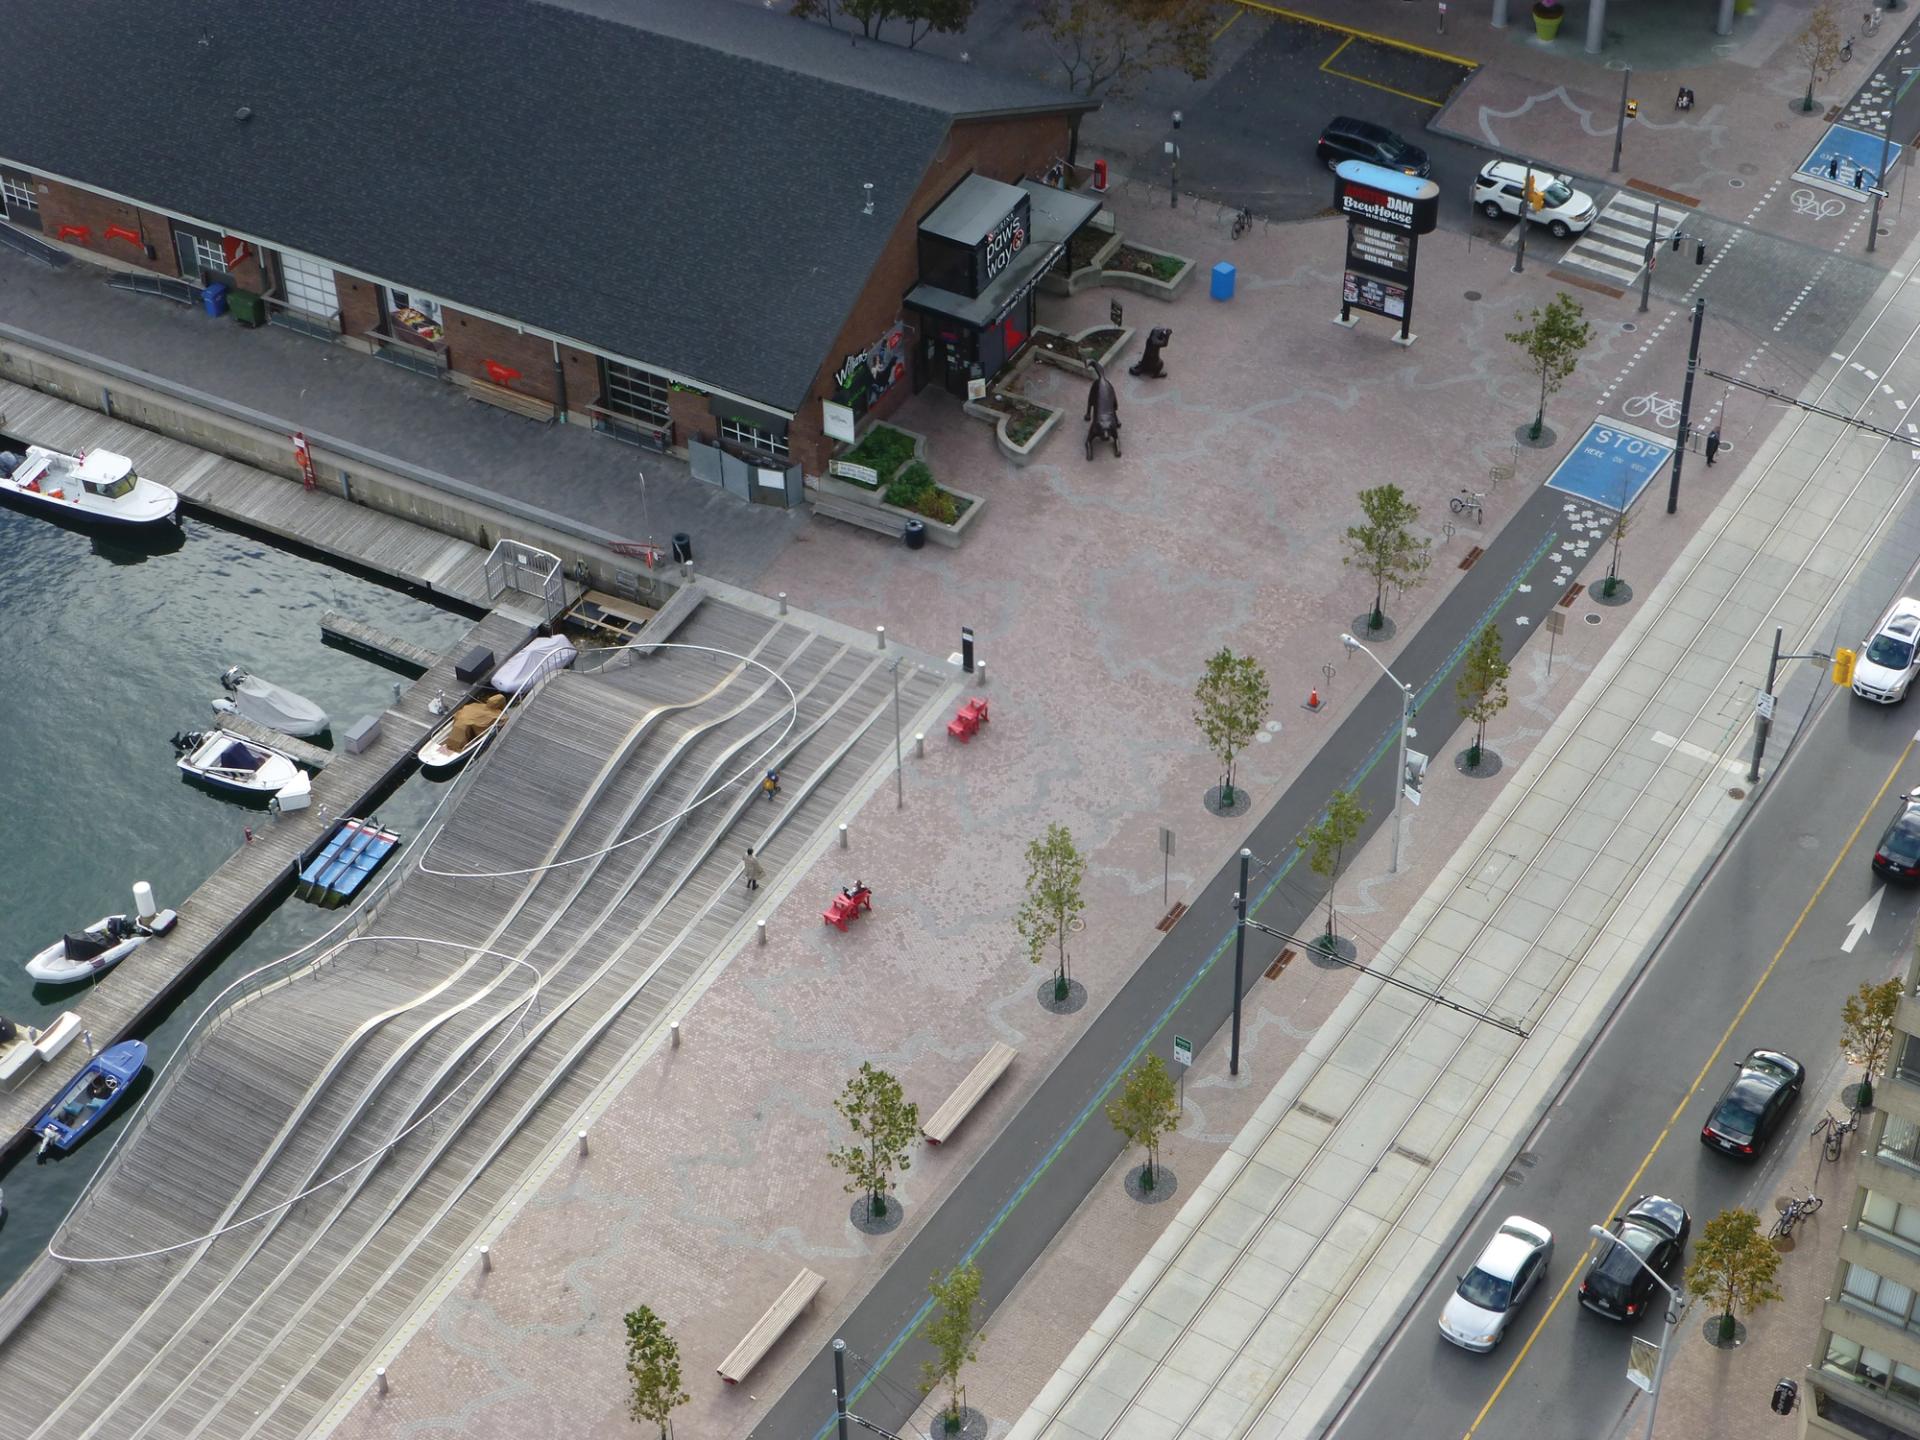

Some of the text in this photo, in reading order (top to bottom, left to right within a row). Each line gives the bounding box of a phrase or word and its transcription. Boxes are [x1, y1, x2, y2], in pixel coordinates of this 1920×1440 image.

[1342, 195, 1412, 224] BrewHouse
[986, 216, 1020, 265] paws
[1380, 231, 1397, 242] OPE
[987, 243, 1013, 279] way
[1583, 447, 1606, 459] HERE
[1595, 429, 1660, 458] STOP
